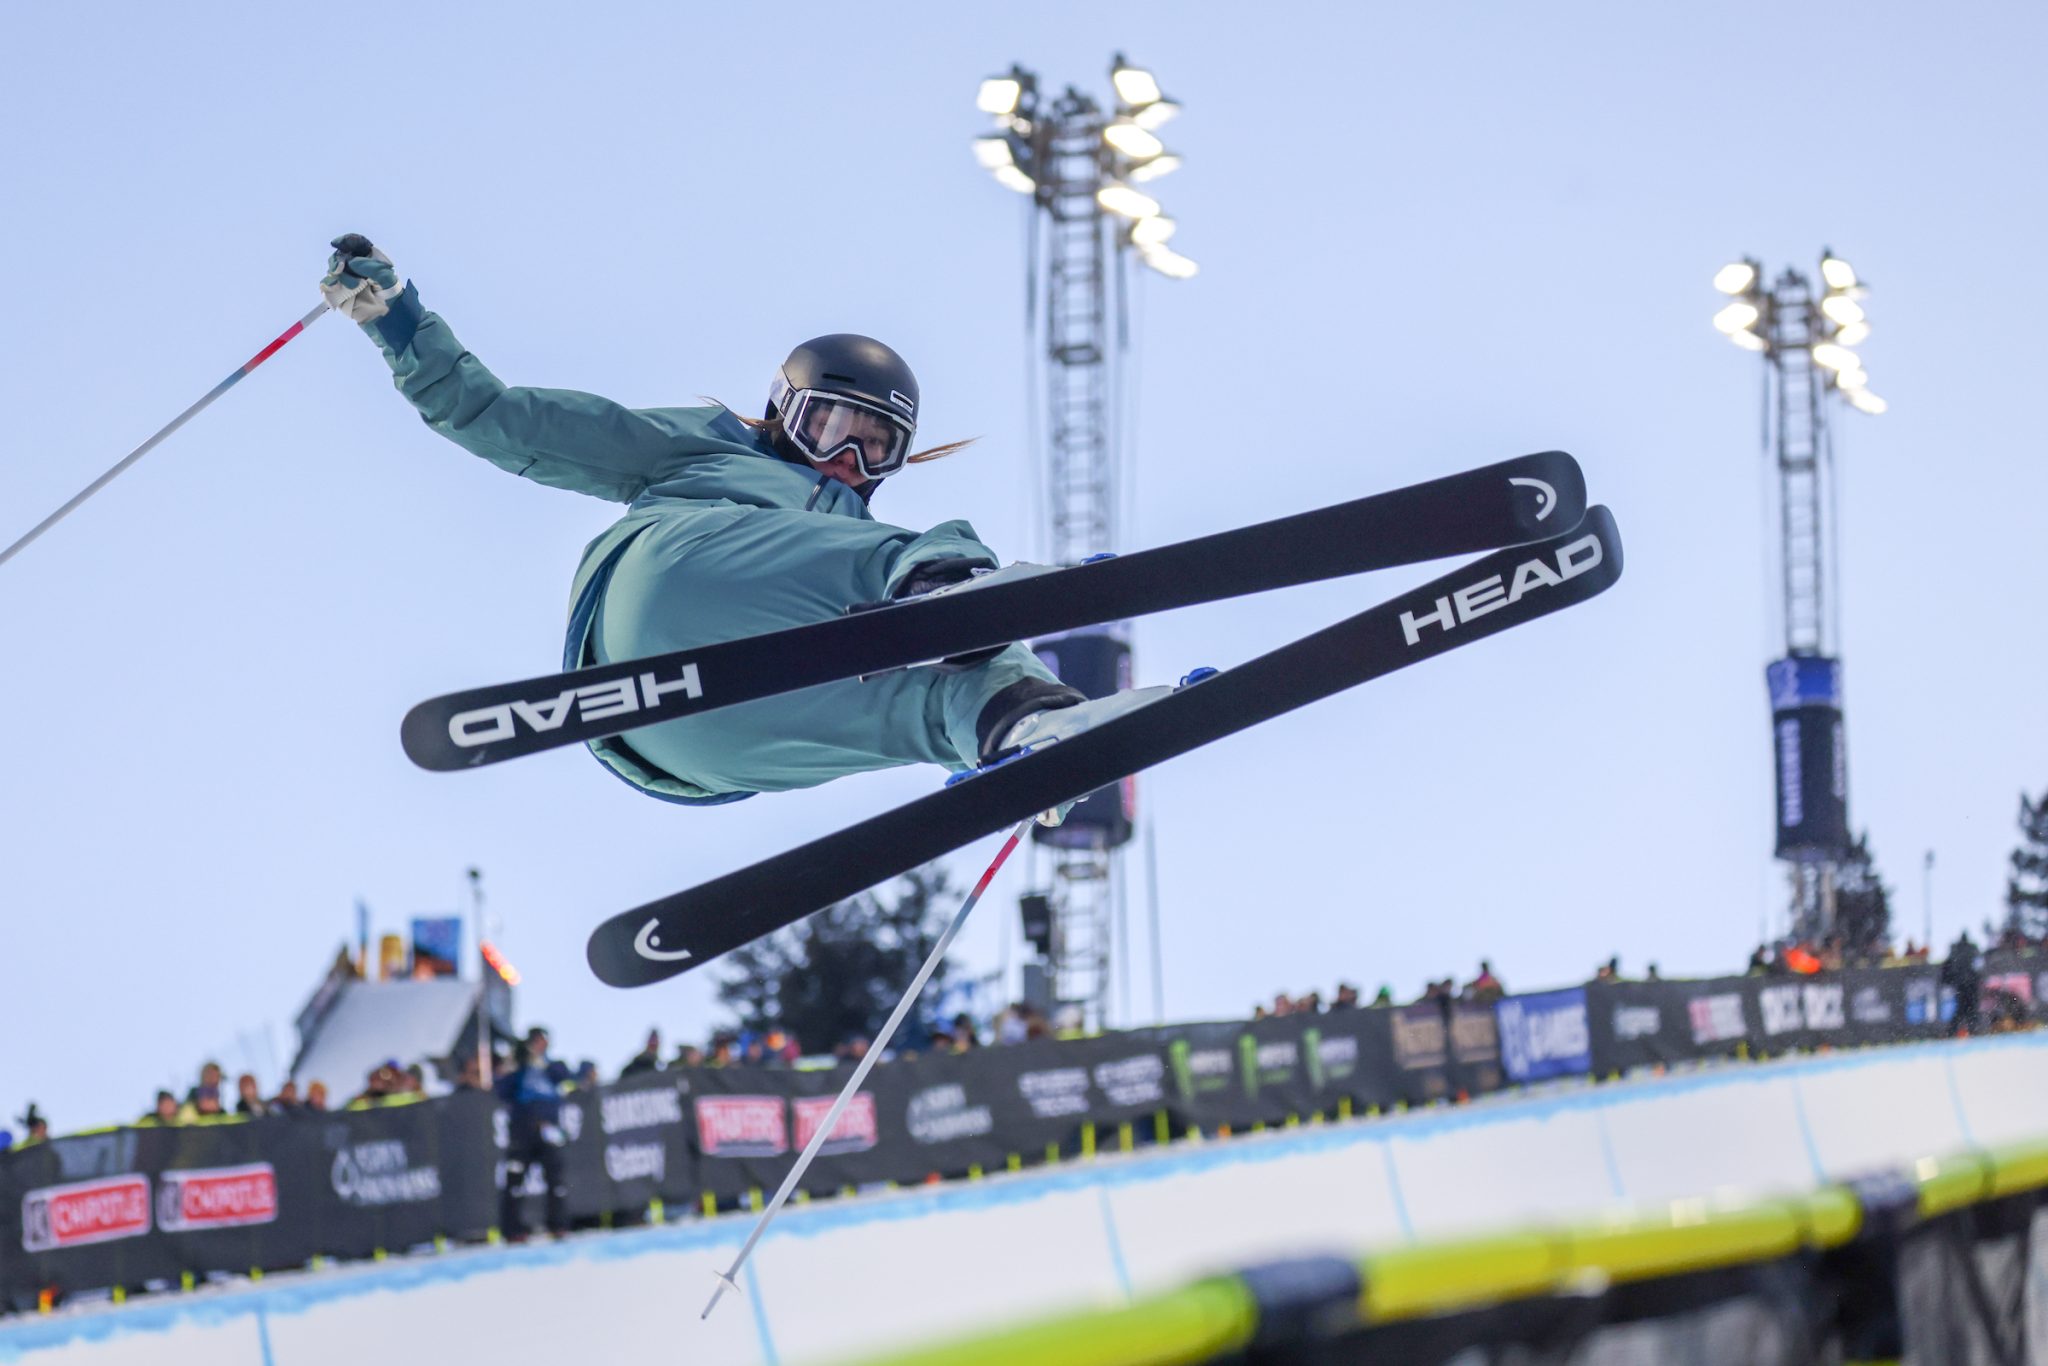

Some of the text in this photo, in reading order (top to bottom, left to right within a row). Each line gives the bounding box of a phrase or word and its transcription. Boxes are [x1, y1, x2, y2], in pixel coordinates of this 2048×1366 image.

[1399, 533, 1603, 646] HEAD
[449, 662, 703, 748] HEAD
[55, 1188, 145, 1234] CHIPOTLE
[184, 1177, 274, 1217] CHIPOTLE
